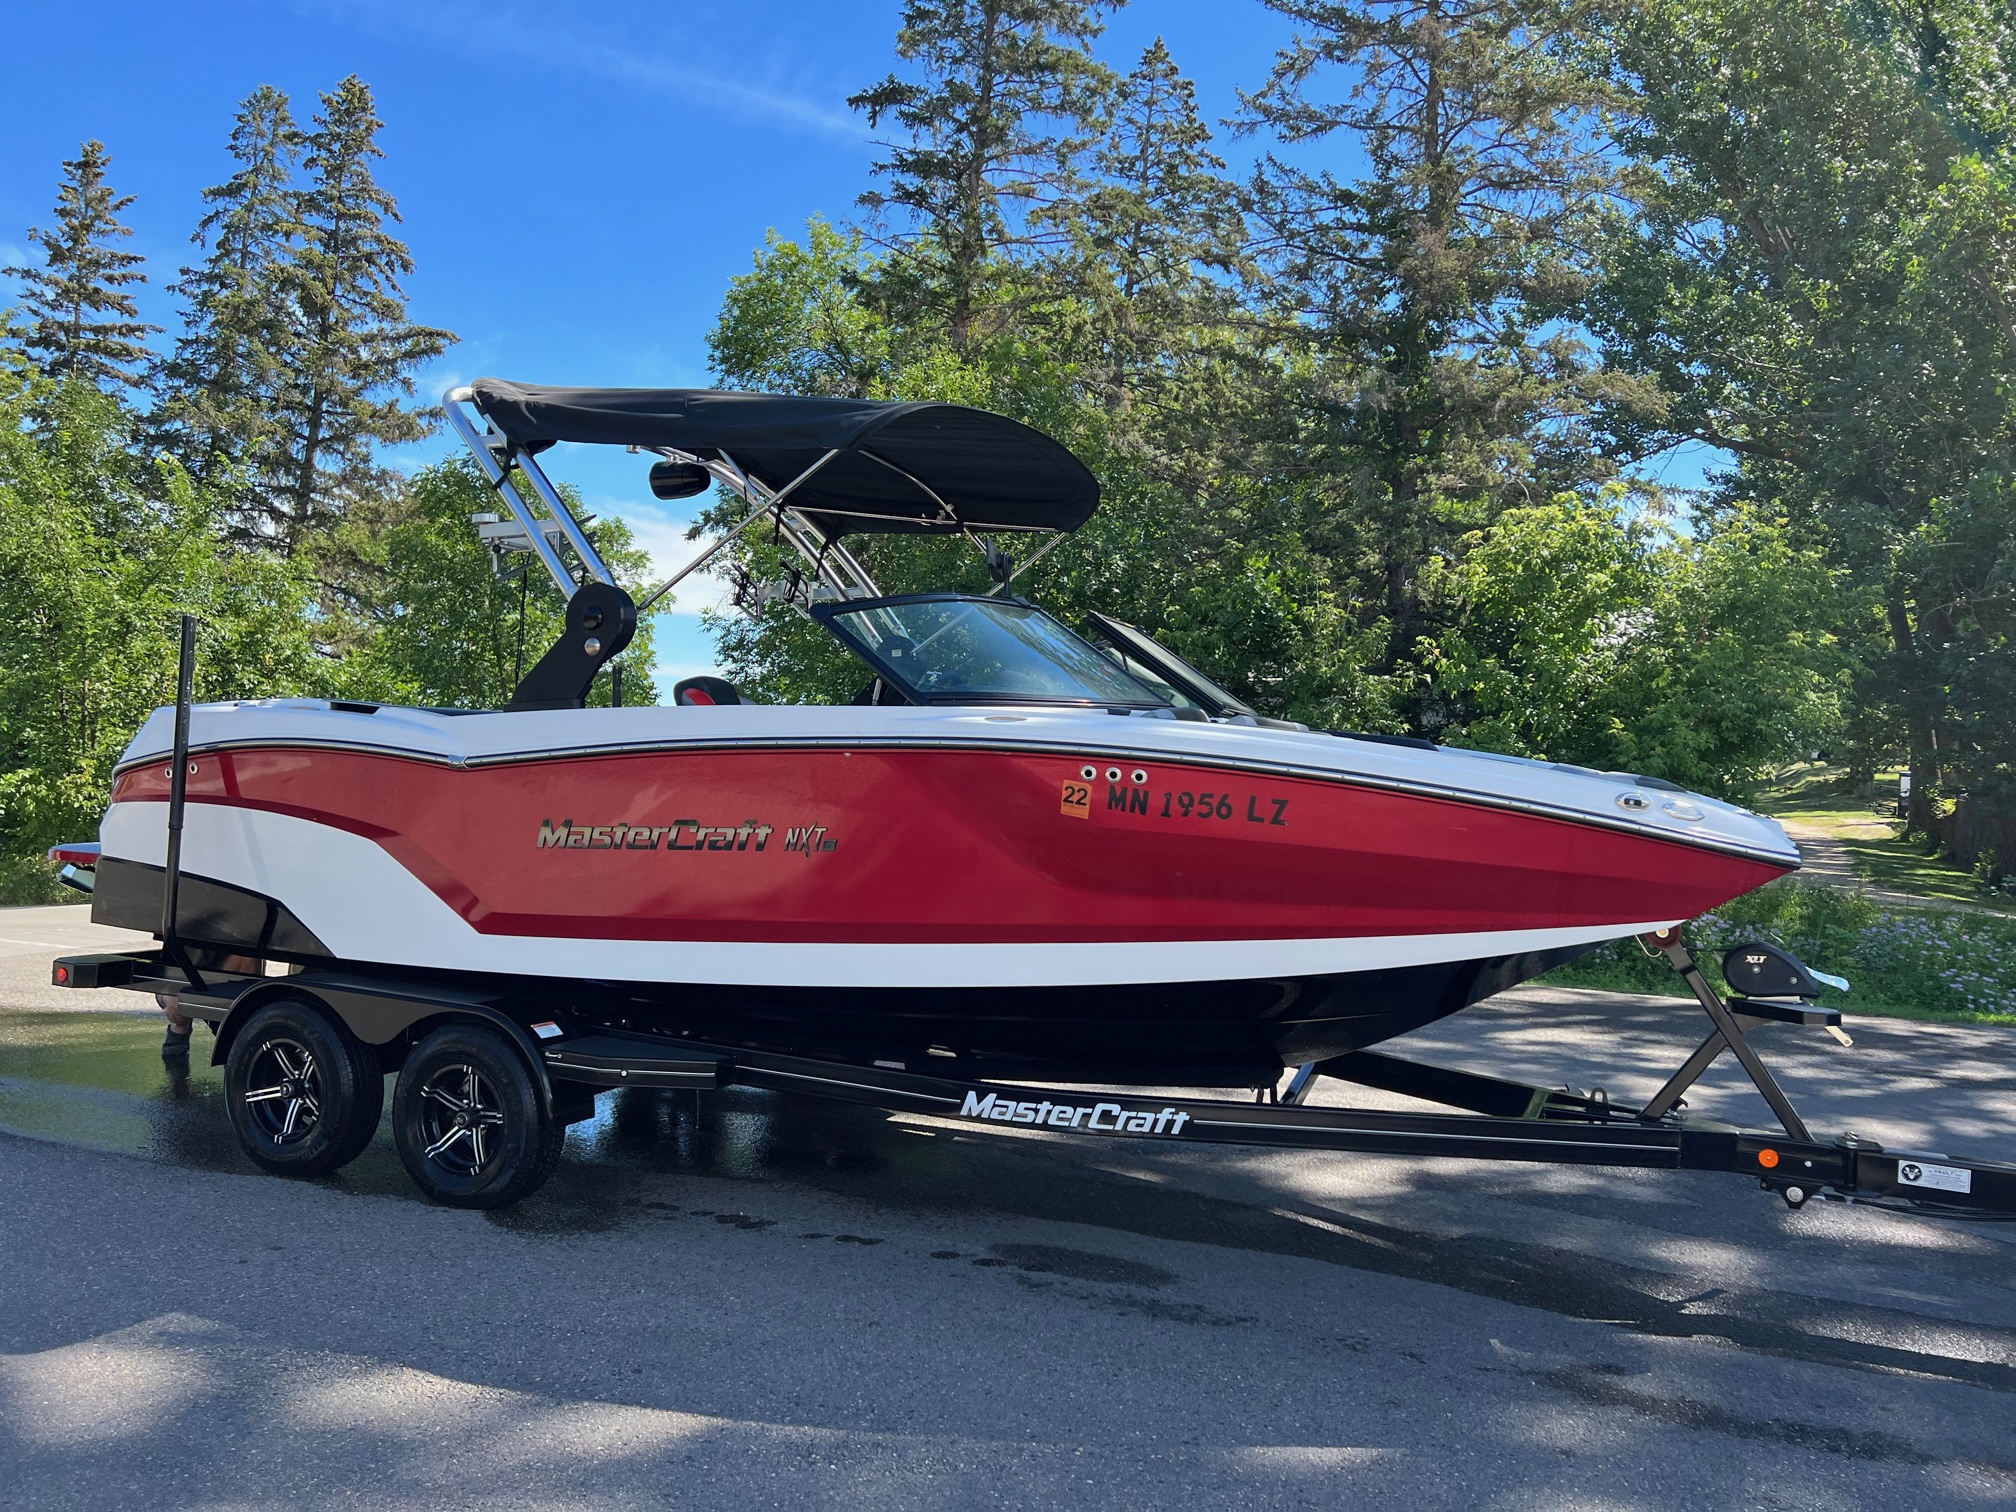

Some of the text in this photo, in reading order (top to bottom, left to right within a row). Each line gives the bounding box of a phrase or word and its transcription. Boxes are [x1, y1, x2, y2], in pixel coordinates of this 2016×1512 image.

[1062, 785, 1088, 807] 22
[1106, 785, 1149, 816] MN
[1160, 791, 1233, 820] 1956
[536, 817, 828, 858] MasterCraft NXT
[1744, 954, 1767, 964] XLT
[960, 1090, 1191, 1135] MasterCraft
